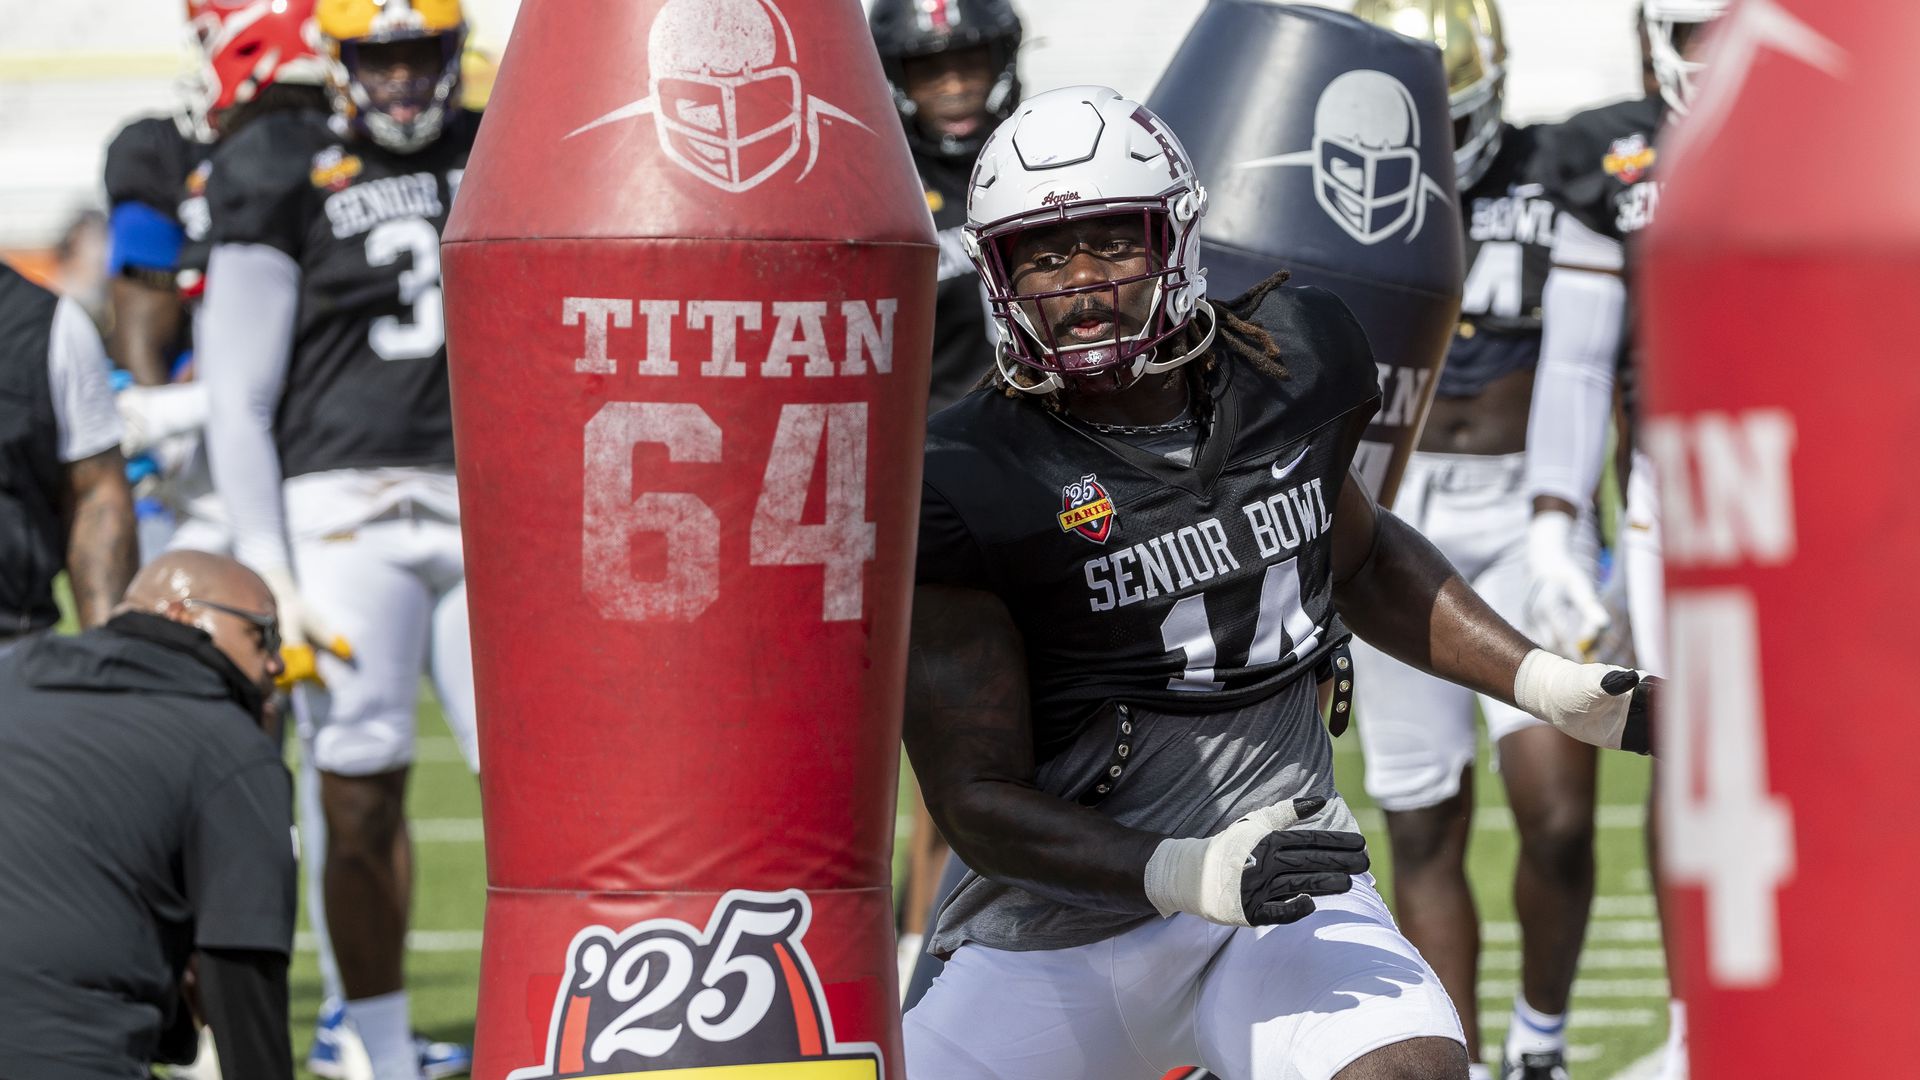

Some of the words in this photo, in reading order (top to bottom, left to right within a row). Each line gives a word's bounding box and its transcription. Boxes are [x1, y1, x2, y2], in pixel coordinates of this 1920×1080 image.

[1041, 190, 1082, 207] Aggies
[562, 297, 898, 378] TITAN
[582, 401, 877, 622] 64
[1063, 500, 1112, 526] PANIN
[1084, 517, 1241, 612] SENIOR
[1242, 477, 1333, 559] BOWL
[1159, 556, 1325, 692] 14
[579, 907, 797, 1063] '25
